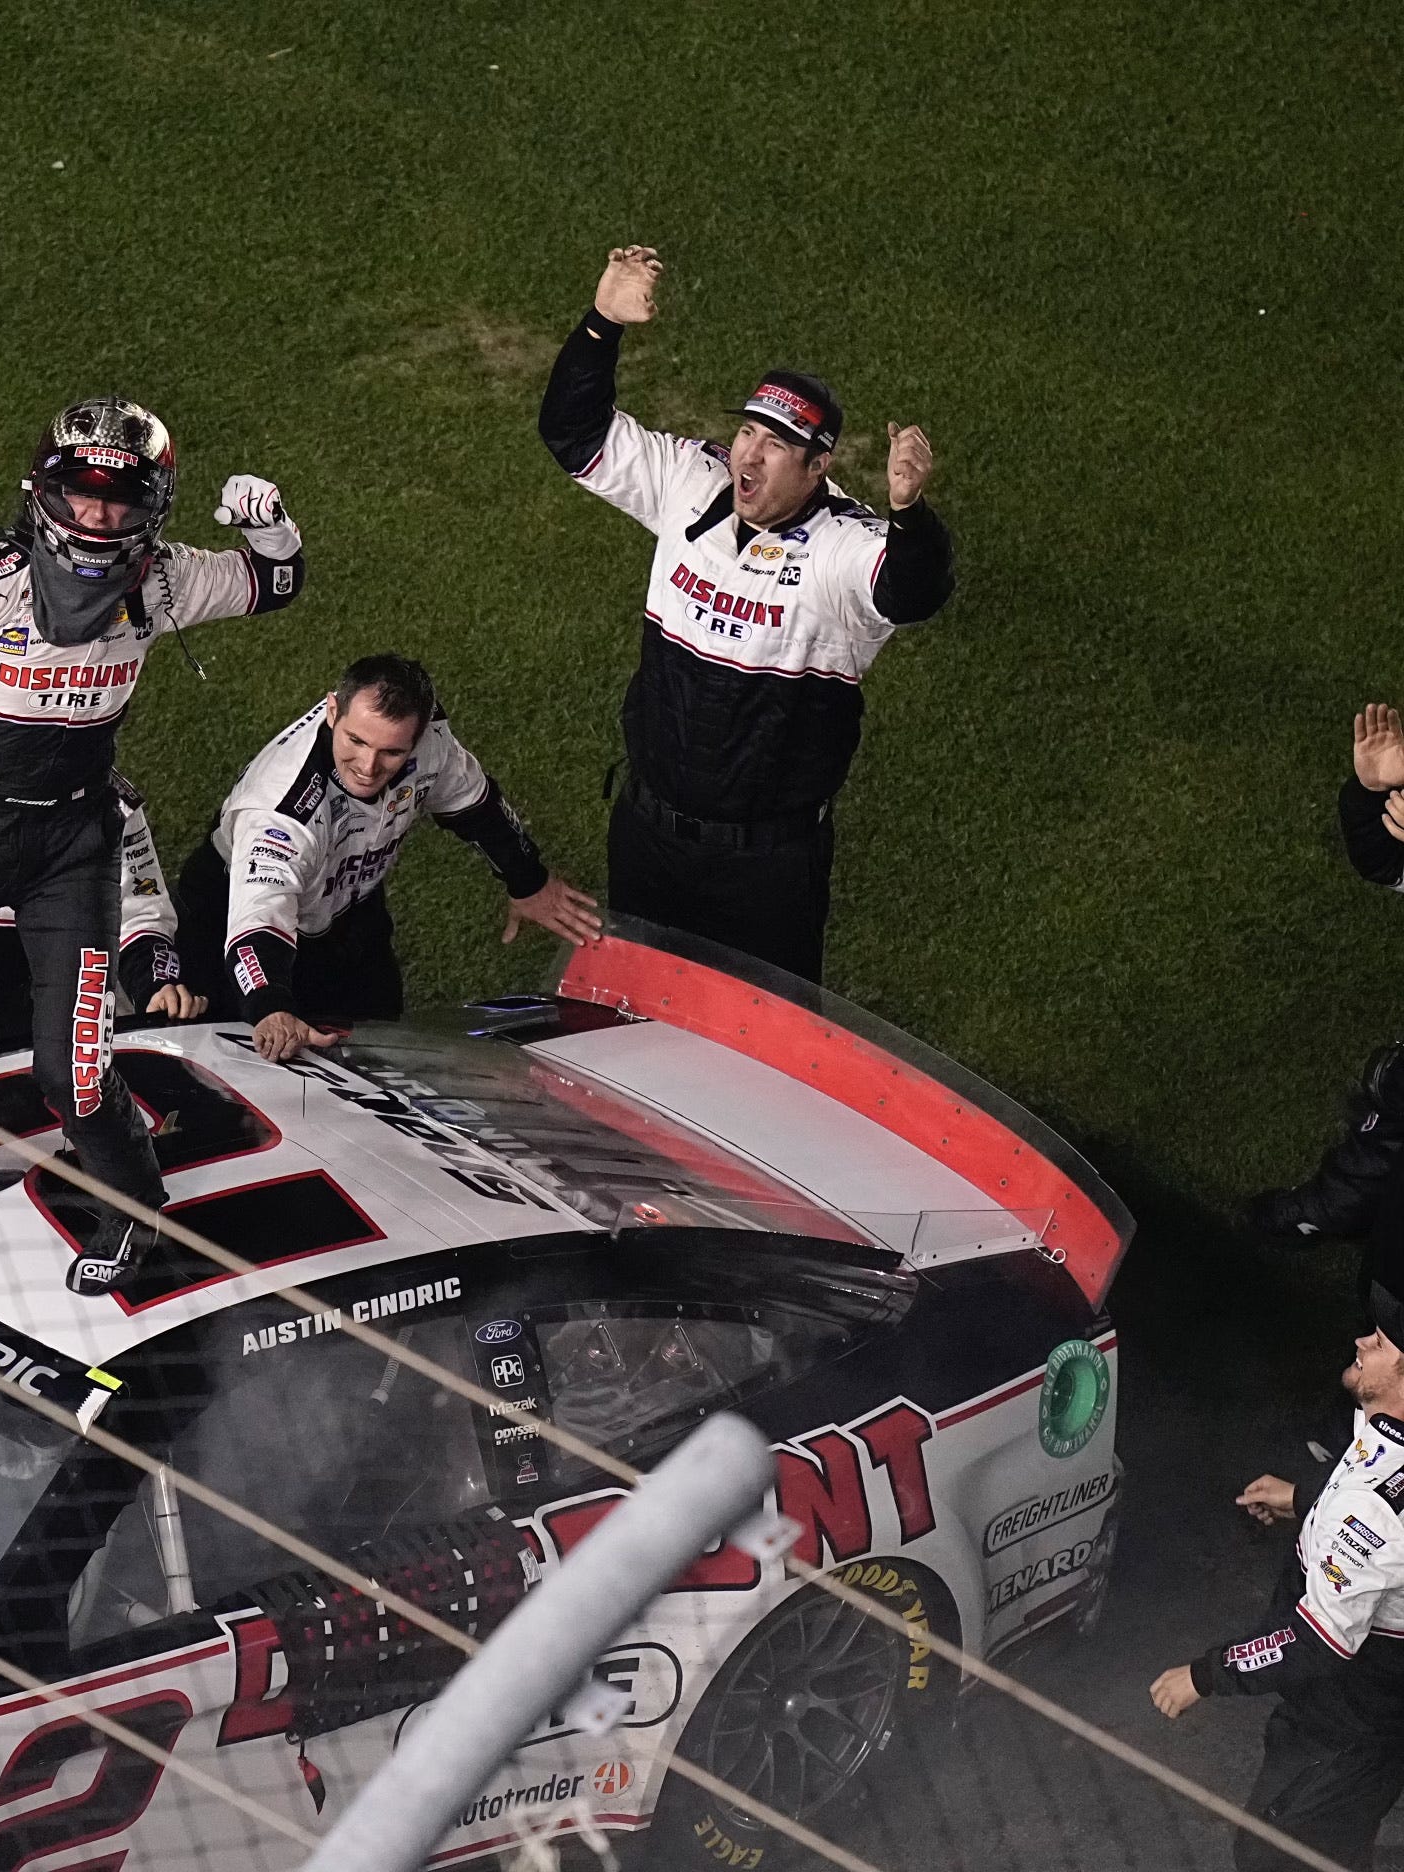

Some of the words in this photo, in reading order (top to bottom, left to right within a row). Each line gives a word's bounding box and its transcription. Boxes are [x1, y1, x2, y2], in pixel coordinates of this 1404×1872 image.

[74, 446, 139, 467] DISCOUNT
[91, 456, 120, 467] TIRE
[72, 553, 113, 564] MENARDS
[780, 567, 801, 585] PPG
[670, 563, 784, 627] DISOUNT
[695, 605, 743, 639] TRE
[38, 692, 103, 708] TIRE
[73, 948, 109, 1117] DISCOUNT
[242, 1308, 342, 1356] AUSTIN
[352, 1277, 462, 1324] CINDRIC
[493, 1357, 523, 1383] PPG
[489, 1396, 538, 1417] Mazak
[494, 1422, 541, 1441] ODYSSEY
[495, 1433, 541, 1446] BATTERY
[992, 1472, 1110, 1547] FREIGHTLINER
[1337, 1528, 1373, 1561] Mazak
[1353, 1519, 1383, 1548] NASCAR
[1337, 1548, 1365, 1570] DETROIT
[1320, 1560, 1352, 1587] SUNOCO
[1243, 1651, 1279, 1669] TIRE
[455, 1773, 585, 1829] utotrader
[694, 1814, 764, 1871] EAGLE
